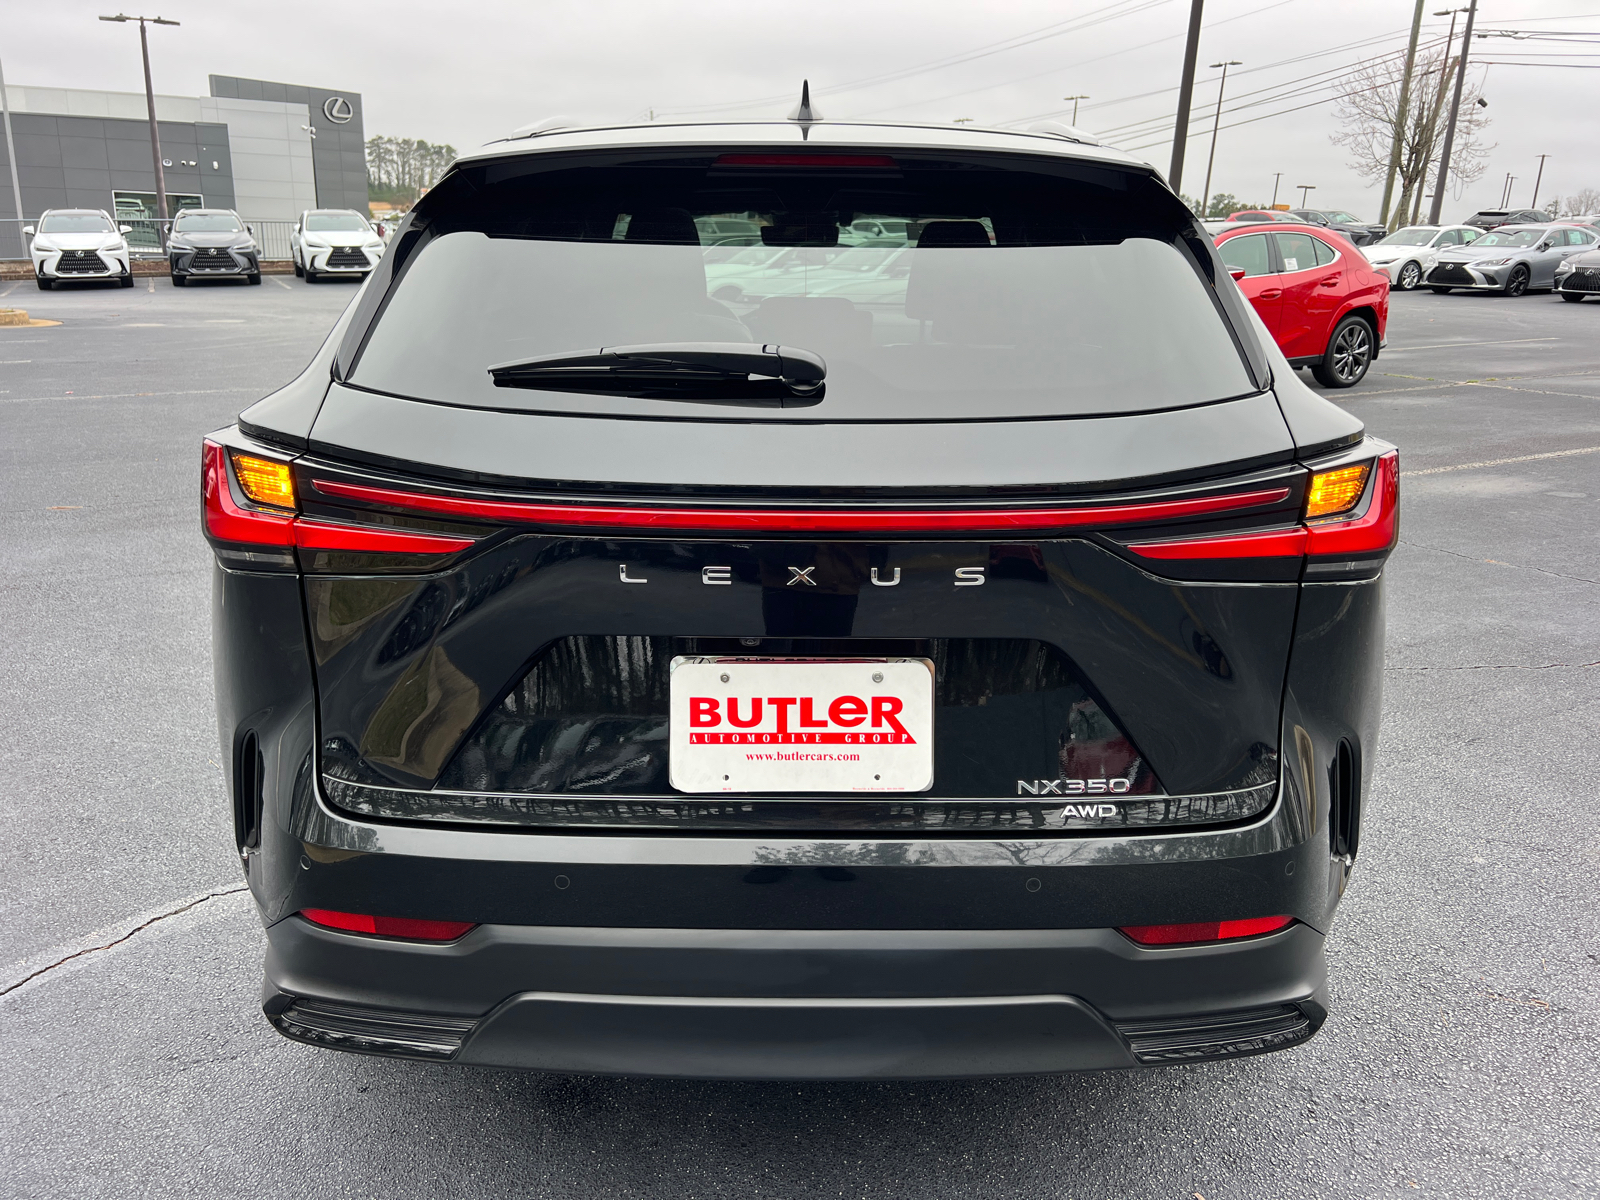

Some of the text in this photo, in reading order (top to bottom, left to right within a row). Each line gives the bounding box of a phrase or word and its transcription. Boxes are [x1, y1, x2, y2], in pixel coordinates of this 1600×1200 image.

[619, 564, 986, 587] LEXUS
[690, 733, 909, 744] AUTOMOTIVE GROUP
[746, 751, 860, 762] www.butlercars.com
[1060, 804, 1117, 819] AWD
